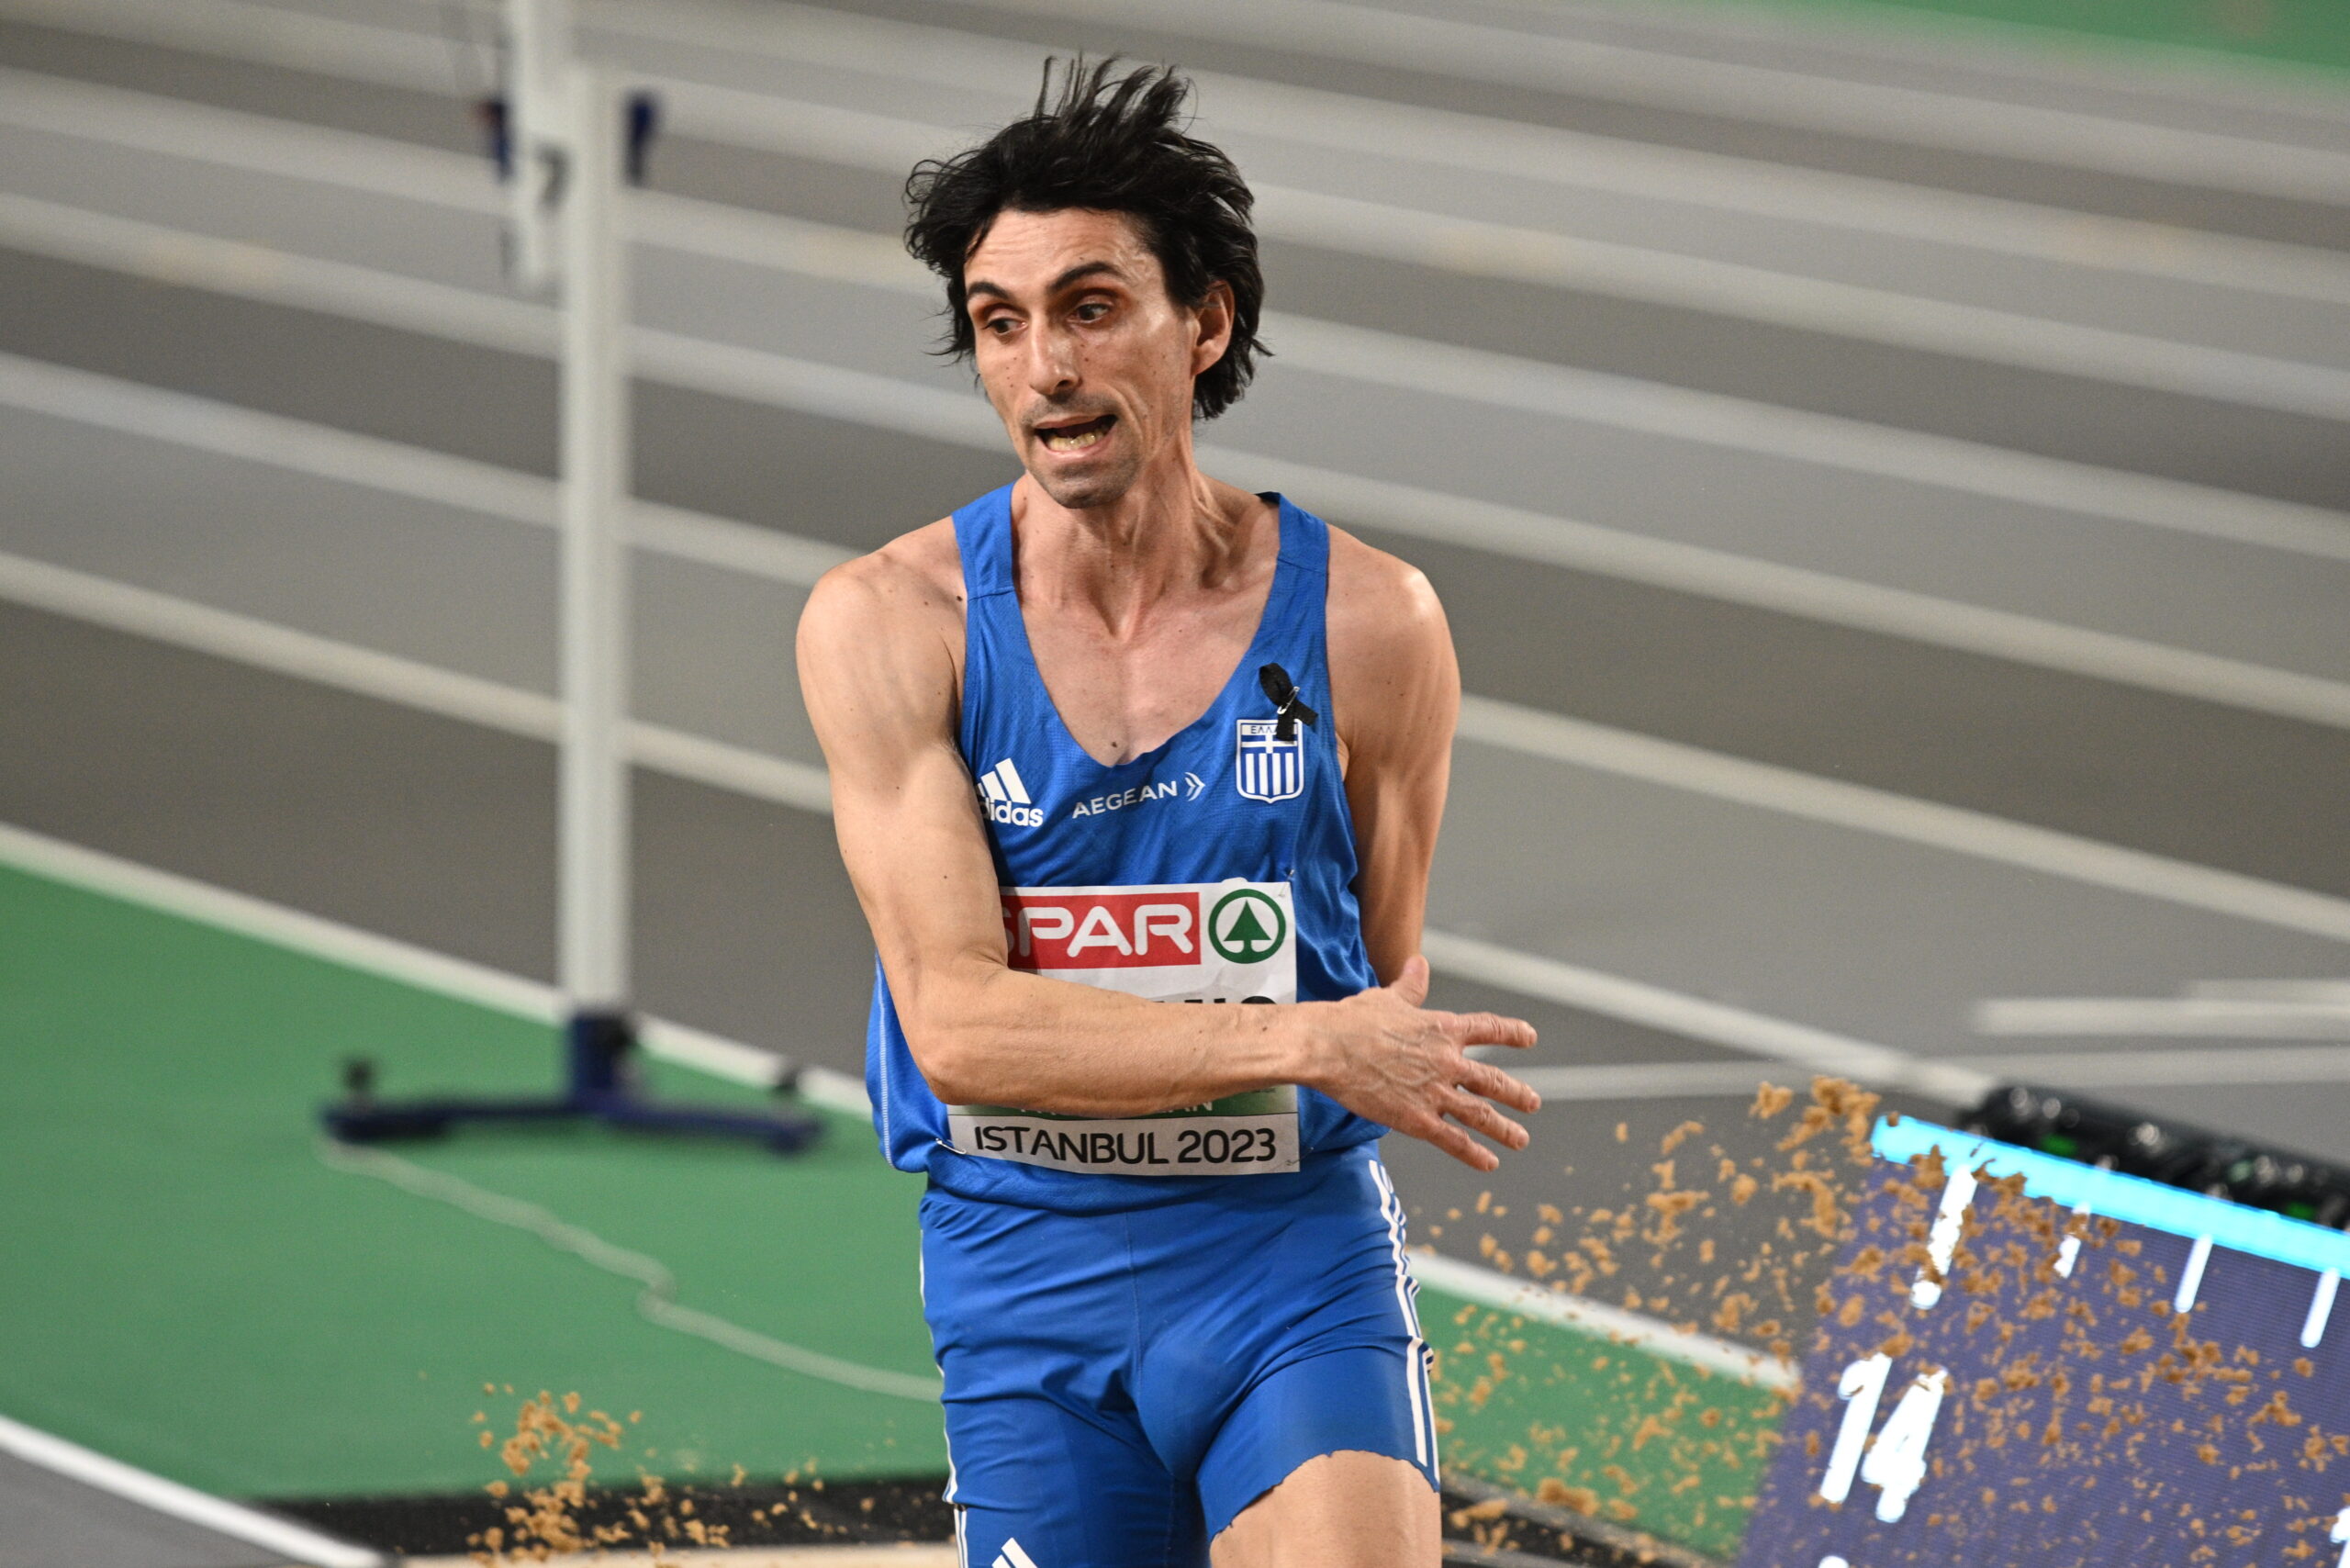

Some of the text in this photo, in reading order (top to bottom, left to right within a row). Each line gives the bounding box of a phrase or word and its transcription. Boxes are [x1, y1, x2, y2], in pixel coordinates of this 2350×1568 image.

[1250, 724, 1278, 734] ΕΛΛ
[979, 796, 1045, 828] didas
[1071, 779, 1179, 820] AEGEAN
[974, 1126, 1277, 1165] ISTANBUL 2023
[1819, 1351, 1949, 1523] 14
